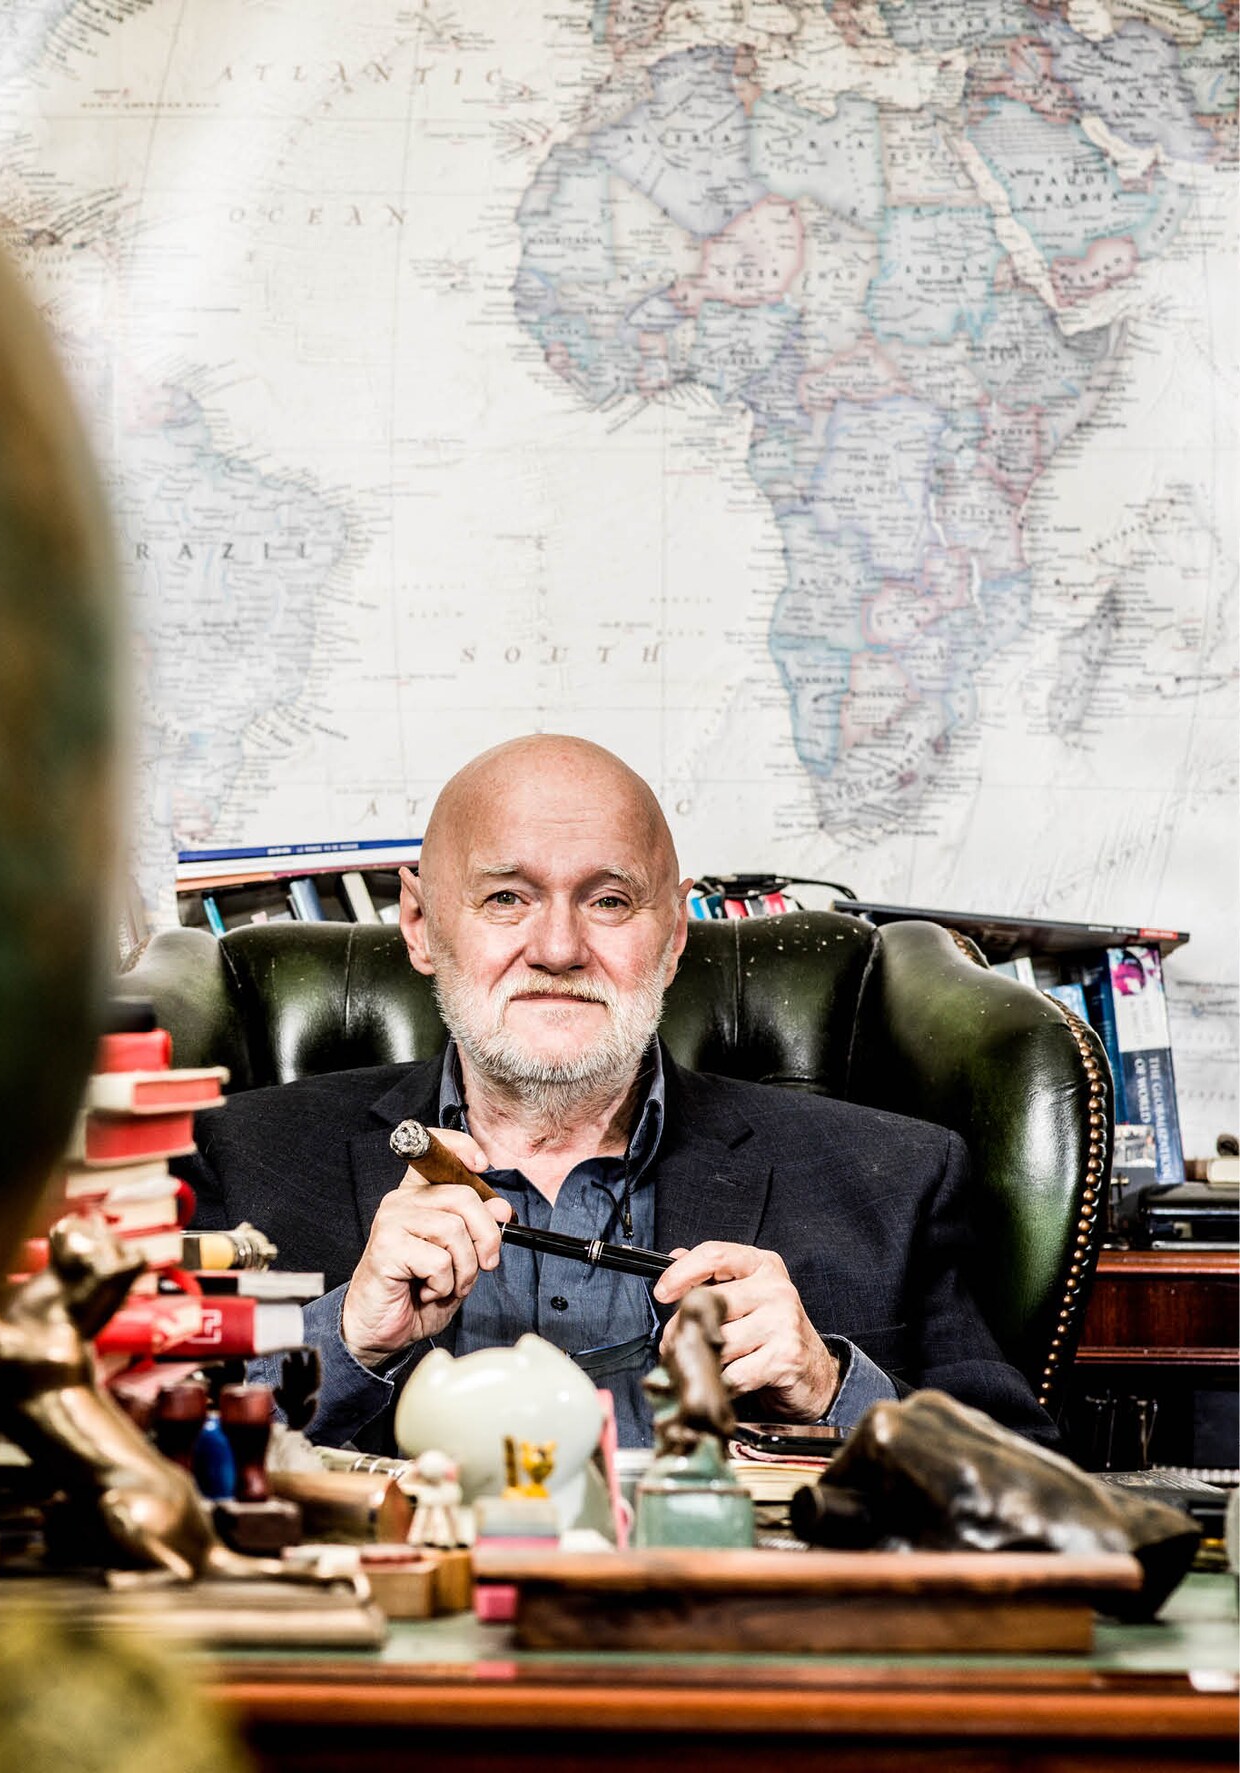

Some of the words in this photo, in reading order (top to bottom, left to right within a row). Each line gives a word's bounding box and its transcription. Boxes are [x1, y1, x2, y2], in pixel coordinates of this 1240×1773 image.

[221, 61, 504, 86] ATLANTIC
[890, 151, 947, 161] EGYPT
[1034, 173, 1108, 187] SAUDI
[1029, 191, 1120, 203] ARABIA
[228, 203, 411, 227] OCEAN
[135, 542, 311, 560] RAZIL
[460, 644, 664, 664] SOUTH
[1134, 1057, 1147, 1075] OF
[1148, 1056, 1162, 1081] THE
[1137, 1076, 1151, 1123] WORLD
